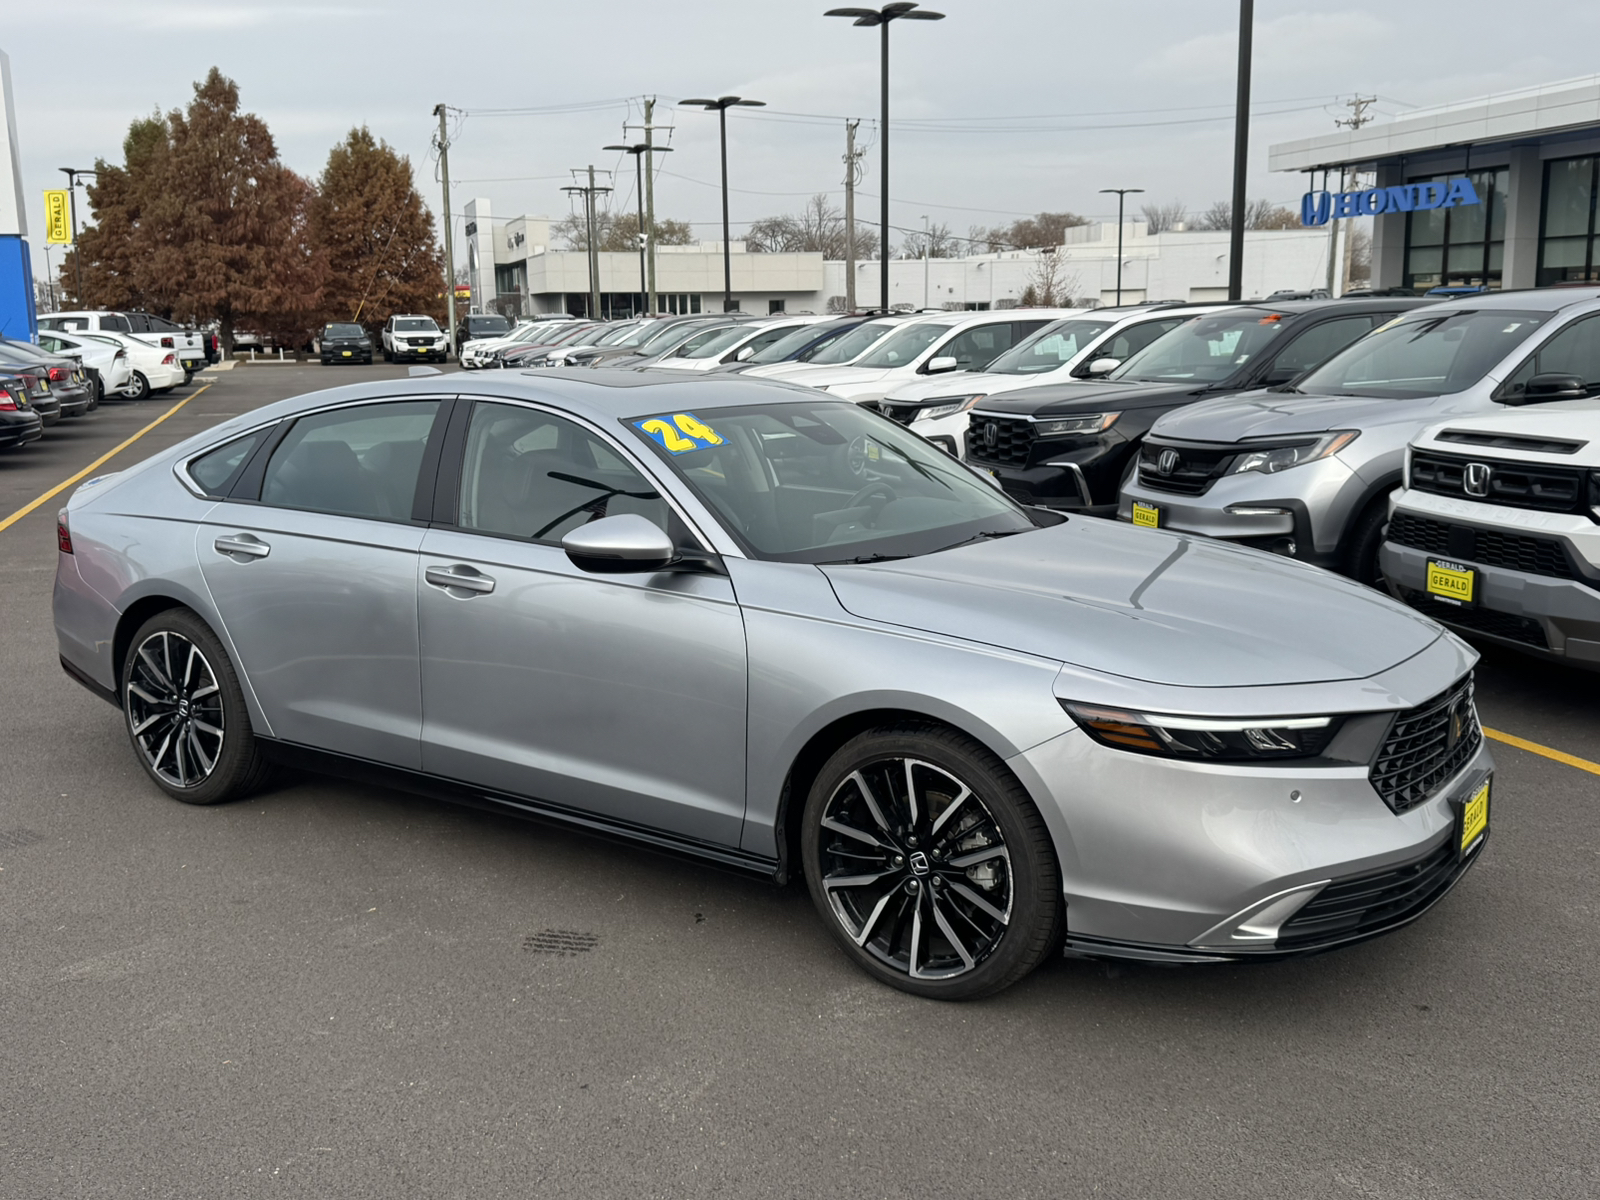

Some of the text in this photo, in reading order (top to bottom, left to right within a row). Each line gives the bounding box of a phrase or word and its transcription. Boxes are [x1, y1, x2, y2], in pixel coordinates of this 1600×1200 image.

[1331, 178, 1481, 218] HONDA
[53, 196, 62, 237] GERALD
[641, 413, 724, 452] 24
[1136, 512, 1155, 523] GERALD
[1436, 560, 1465, 572] GERALD
[1433, 576, 1467, 591] GERALD
